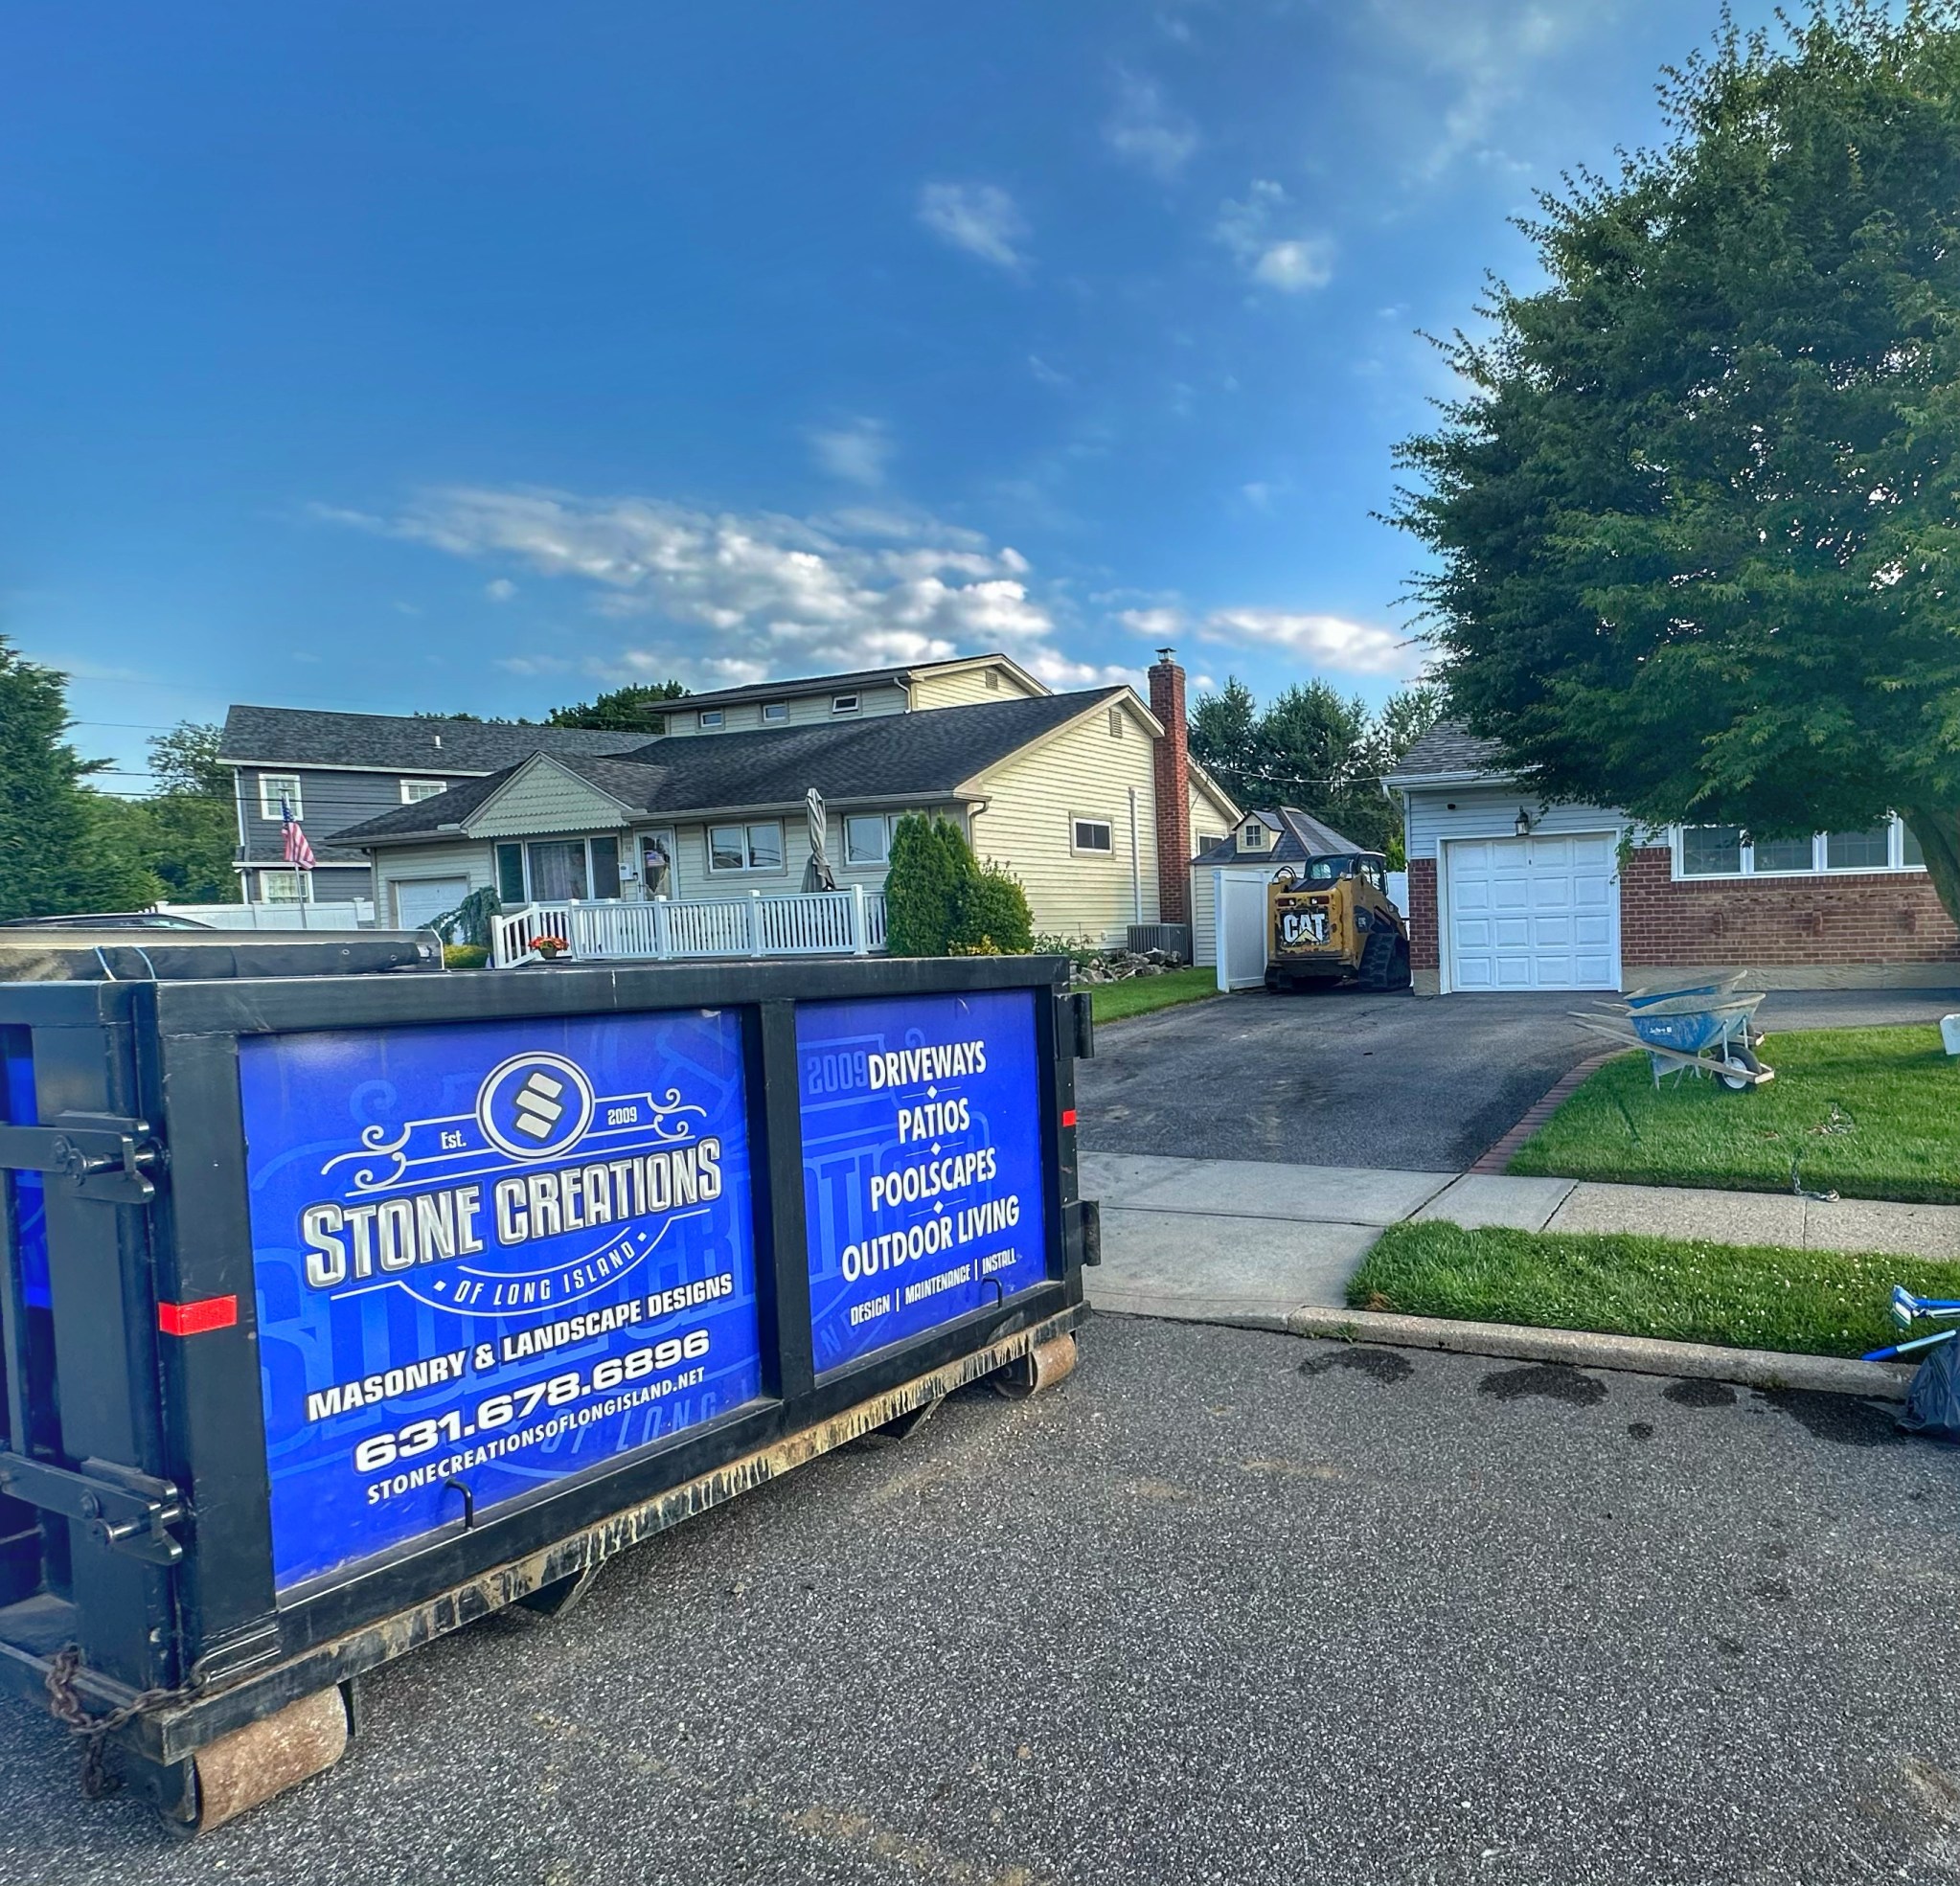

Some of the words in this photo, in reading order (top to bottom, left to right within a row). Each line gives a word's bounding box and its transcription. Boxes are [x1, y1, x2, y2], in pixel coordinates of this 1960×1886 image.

[1283, 913, 1325, 943] CAT
[867, 1040, 987, 1090] DRIVEWAYS
[440, 1129, 467, 1150] Est.
[606, 1107, 638, 1125] 2009
[897, 1098, 970, 1144] PATIOS
[302, 1187, 484, 1289] STONE
[494, 1138, 722, 1245] CREATIONS
[870, 1147, 997, 1213] POOLSCAPES
[453, 1282, 484, 1305] OF
[493, 1281, 552, 1307] LONG
[562, 1240, 636, 1296] ISLAND
[841, 1216, 953, 1283] OUTDOOR
[957, 1194, 1020, 1244] LIVING
[850, 1293, 891, 1327] DESIGN
[904, 1262, 971, 1305] MAINTENANCE
[981, 1247, 1017, 1275] INSTALL
[307, 1351, 467, 1422] MASONRY
[474, 1343, 496, 1372] &
[502, 1301, 642, 1362] LANDSCAPE
[647, 1272, 733, 1317] DESIGNS
[354, 1329, 711, 1475] 631.678.6896
[366, 1366, 705, 1506] STONECREATIONSOFLONGISLAND.NET
